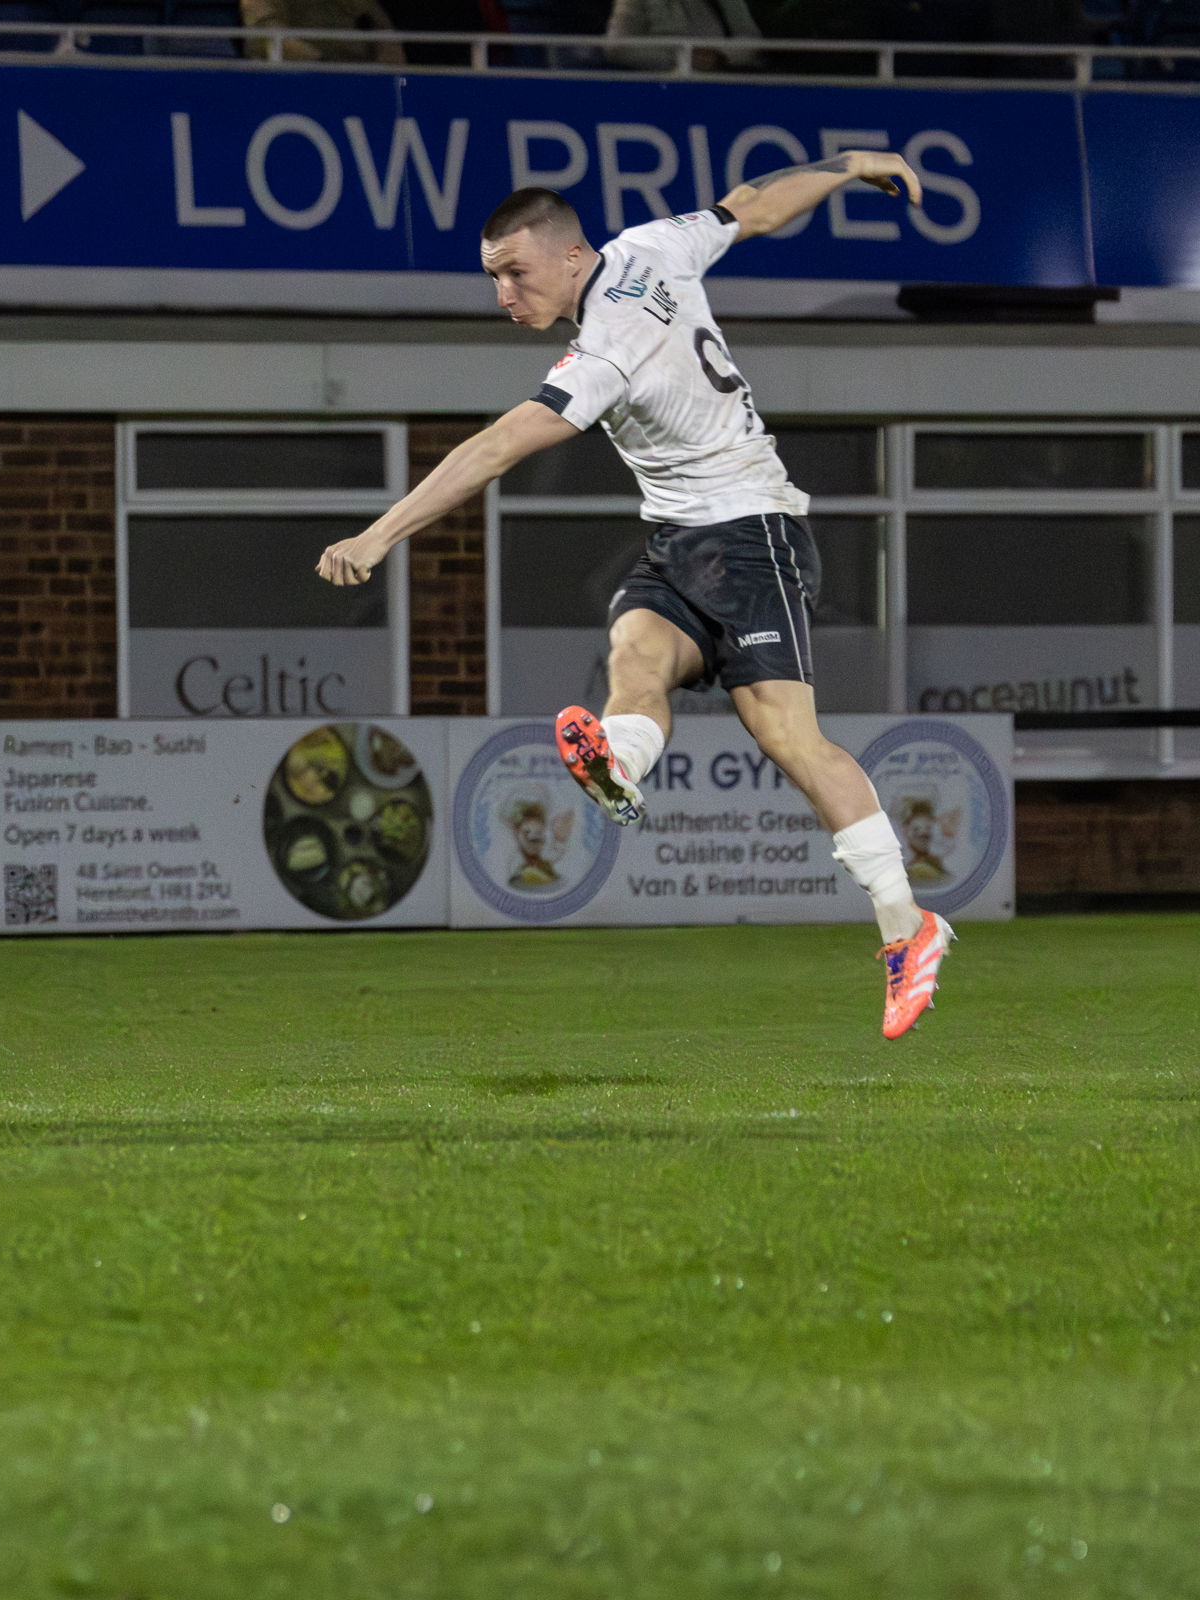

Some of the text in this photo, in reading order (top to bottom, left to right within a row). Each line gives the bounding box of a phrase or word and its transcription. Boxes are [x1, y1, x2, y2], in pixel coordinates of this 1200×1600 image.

[170, 112, 470, 231] LOW
[507, 119, 981, 244] PRICES
[175, 654, 346, 714] Celtic
[4, 735, 73, 759] Ramen
[94, 735, 133, 757] Bao
[153, 734, 206, 756] Sushi
[4, 768, 98, 789] Japanese
[710, 752, 790, 790] GY
[4, 791, 70, 813] Fusion
[639, 810, 822, 834] Authentic Gree
[4, 822, 201, 848] Open 7 days a week
[656, 840, 810, 865] Cuisine Food
[627, 872, 838, 898] Van & Restaurant
